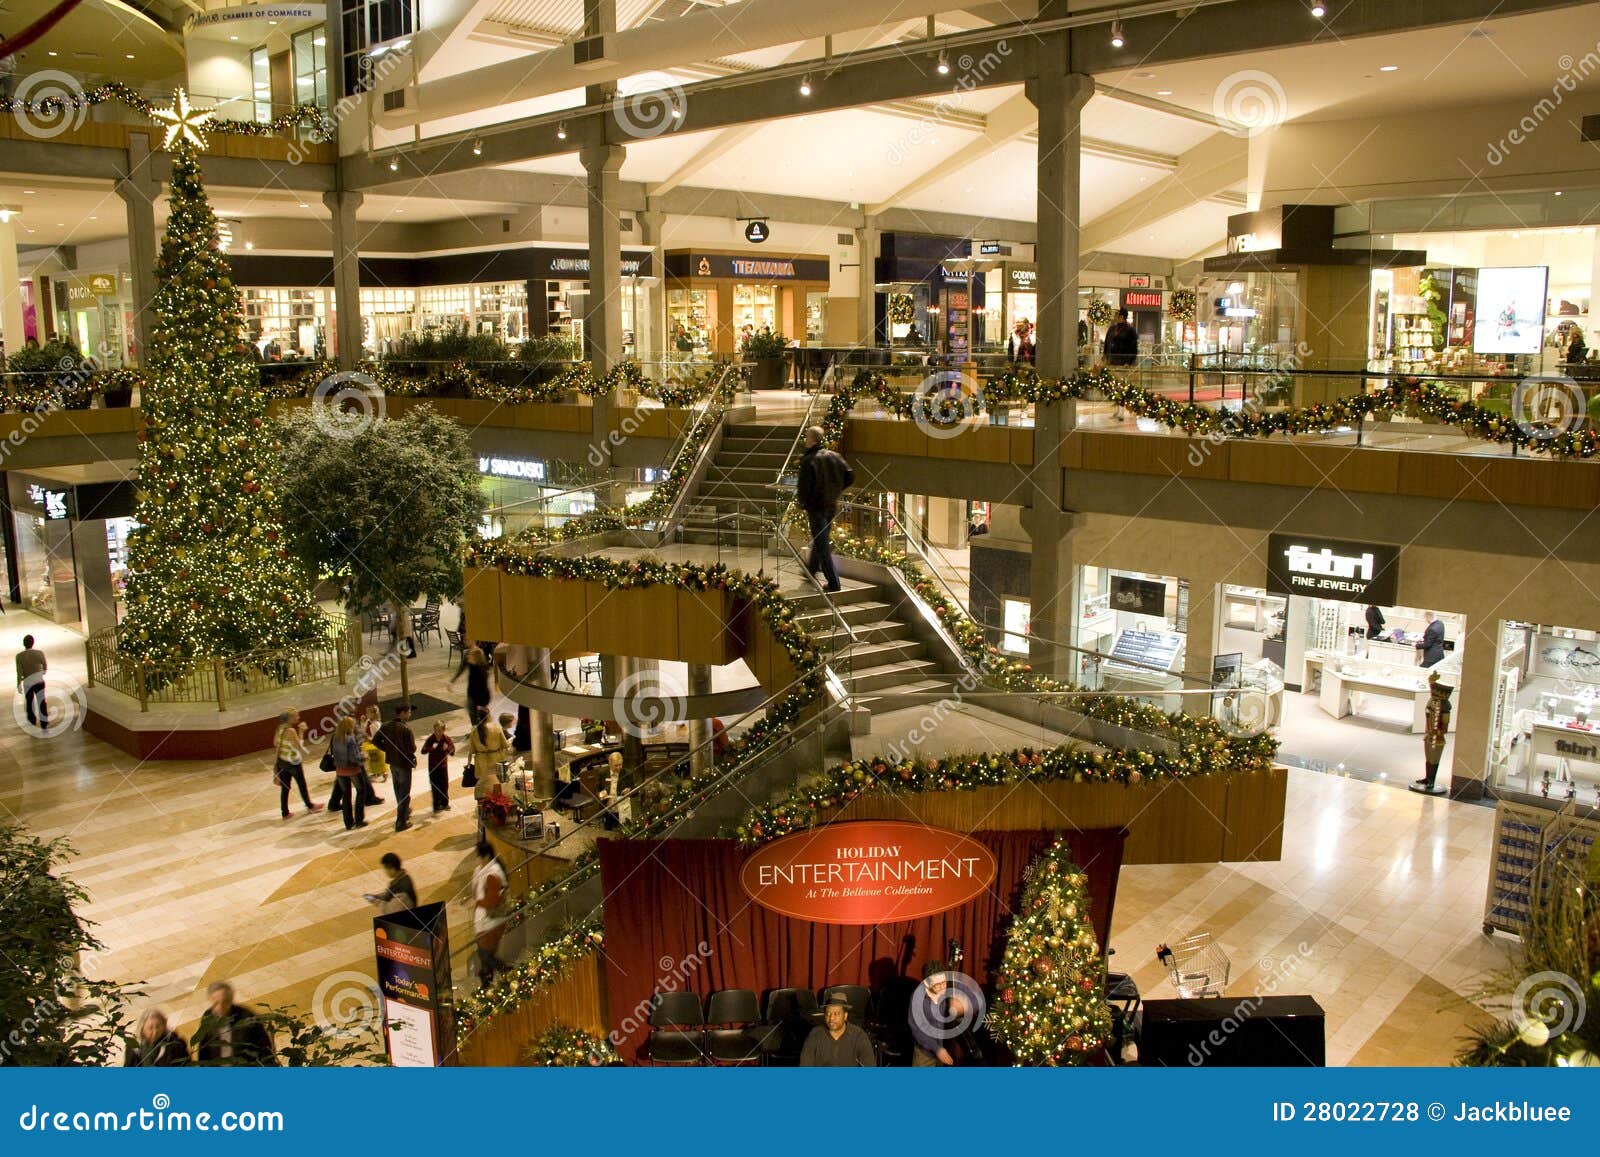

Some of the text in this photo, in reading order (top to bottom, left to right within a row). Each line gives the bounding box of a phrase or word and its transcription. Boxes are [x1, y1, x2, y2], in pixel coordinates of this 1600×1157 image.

[222, 12, 253, 20] CHAMBER
[255, 10, 265, 18] OF
[267, 9, 312, 17] COMMERCE
[732, 260, 796, 276] TEAVANA
[1012, 270, 1037, 281] GODIVA
[1292, 575, 1367, 593] FINE JEWELRY
[836, 845, 902, 860] HOLIDAY
[758, 857, 981, 886] ENTERTAINMENT
[805, 884, 933, 900] At The Bellevue Collection
[393, 975, 417, 990] Today's
